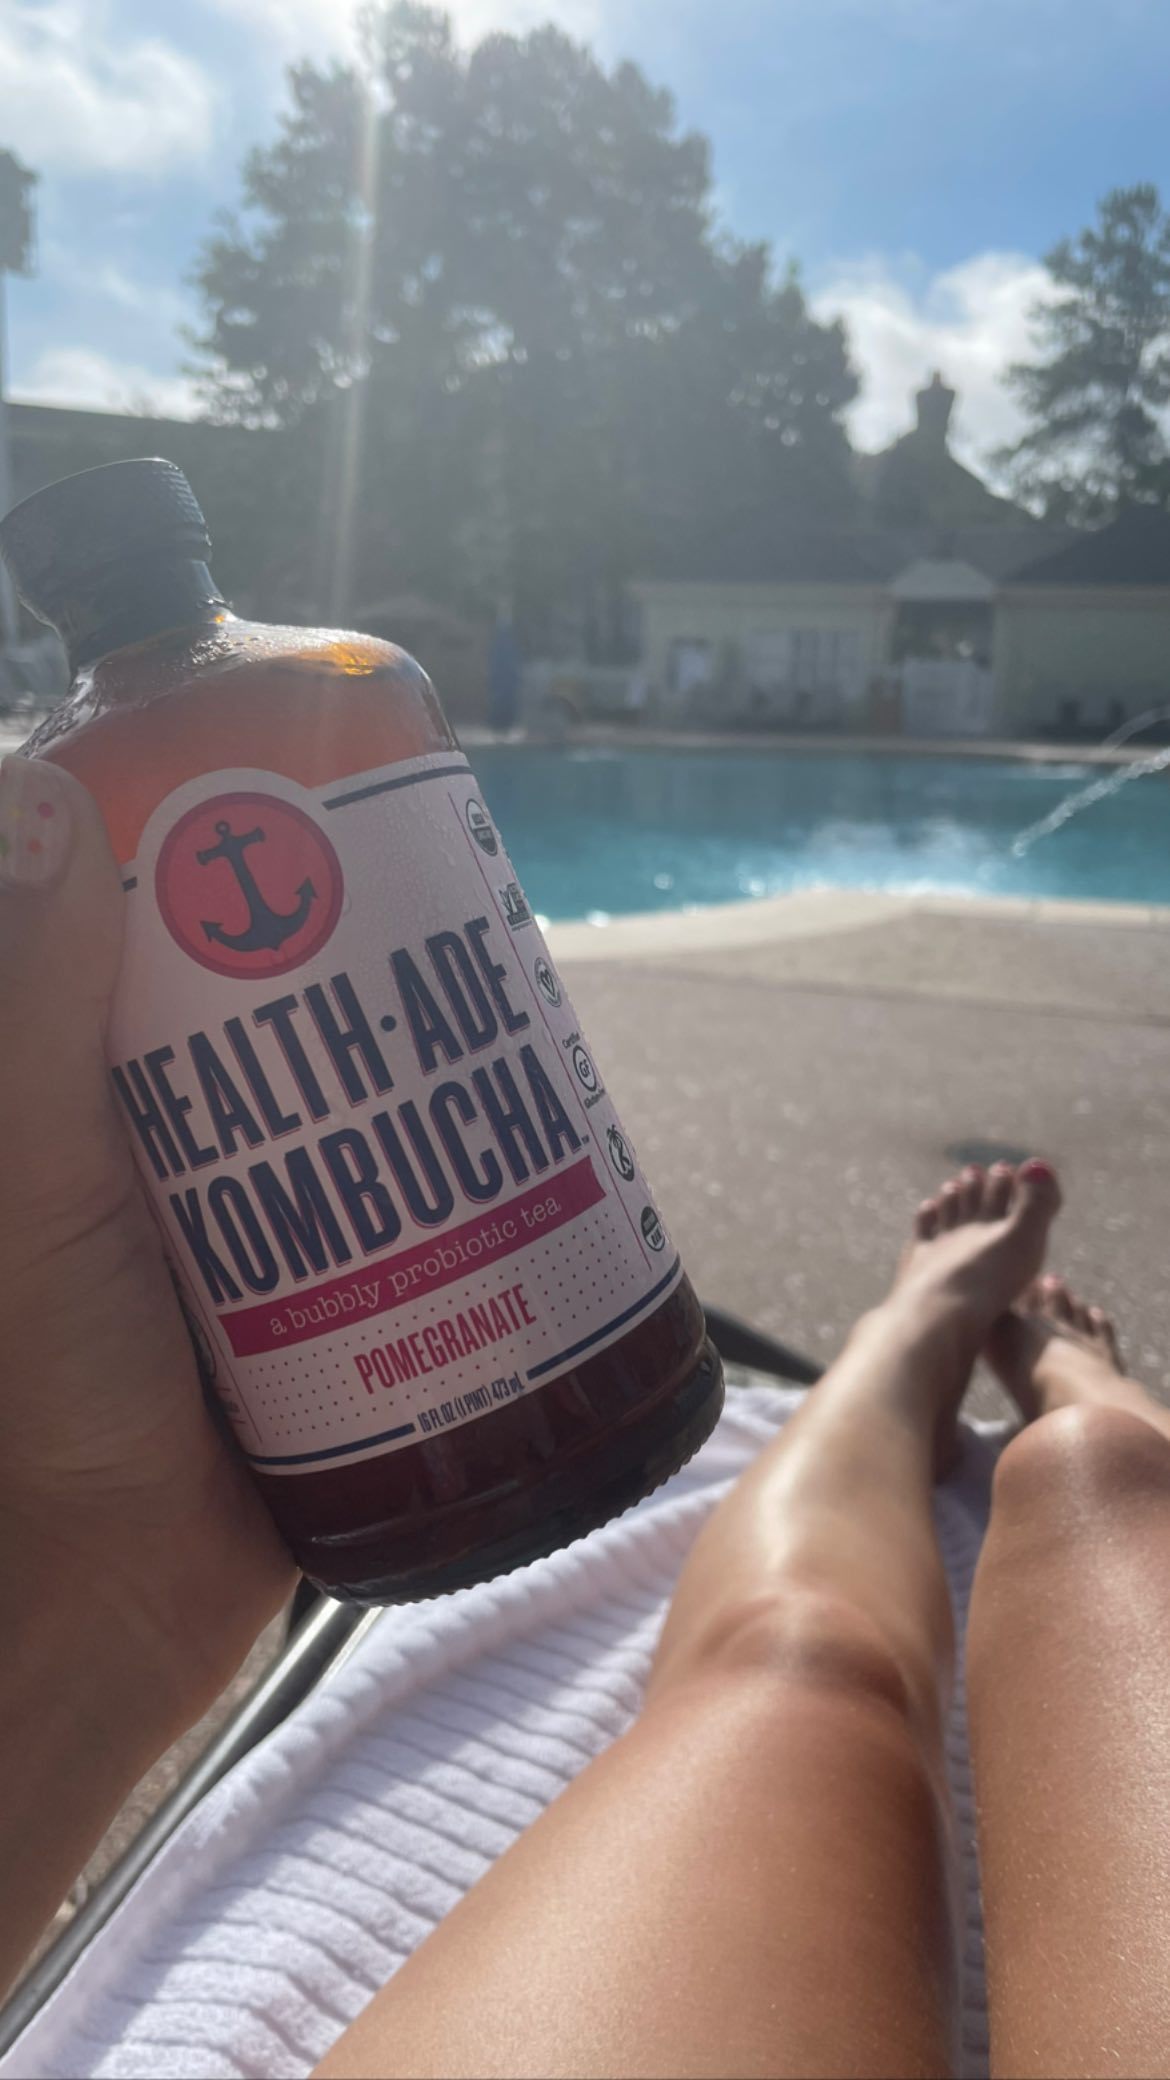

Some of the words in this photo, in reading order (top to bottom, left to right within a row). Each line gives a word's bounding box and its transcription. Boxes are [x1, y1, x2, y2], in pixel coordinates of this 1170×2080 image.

[169, 1044, 583, 1307] KOMBUCHA
[270, 1316, 287, 1336] a
[285, 1279, 380, 1330] bubbly
[388, 1219, 518, 1297] probiotic
[520, 1196, 562, 1229] tea
[353, 1283, 537, 1395] POMEGRANATE
[417, 1411, 433, 1434] 16
[428, 1407, 445, 1430] FL
[440, 1401, 458, 1424] OZ
[491, 1377, 511, 1400] 473
